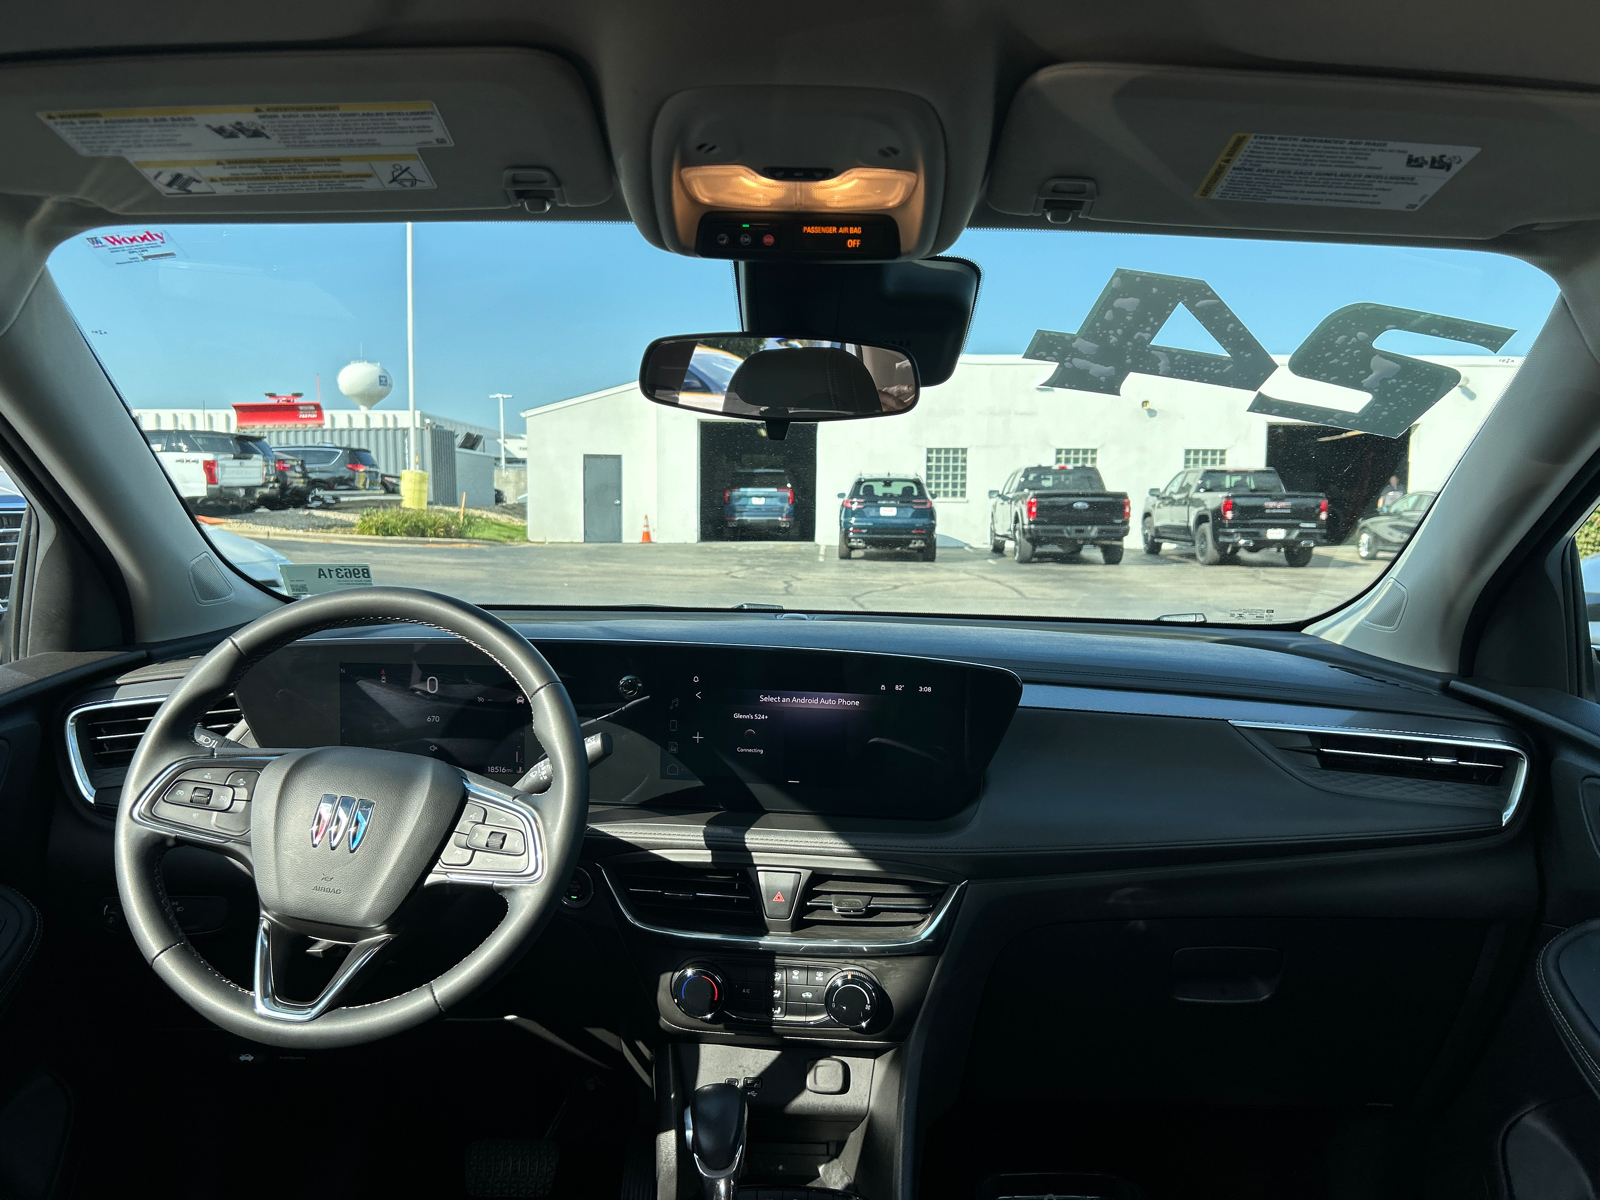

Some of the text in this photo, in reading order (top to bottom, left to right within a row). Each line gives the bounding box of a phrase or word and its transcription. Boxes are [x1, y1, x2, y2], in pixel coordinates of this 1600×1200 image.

[802, 226, 862, 234] PASSENGER AIR BAG
[102, 230, 166, 247] Woody
[846, 239, 861, 248] OFF
[426, 675, 439, 694] 0
[759, 694, 860, 707] Select an Android Auto Phone
[426, 715, 441, 723] 670
[733, 712, 753, 720] Glenn's
[736, 746, 764, 755] Connecting
[311, 885, 342, 895] AIRBAG
